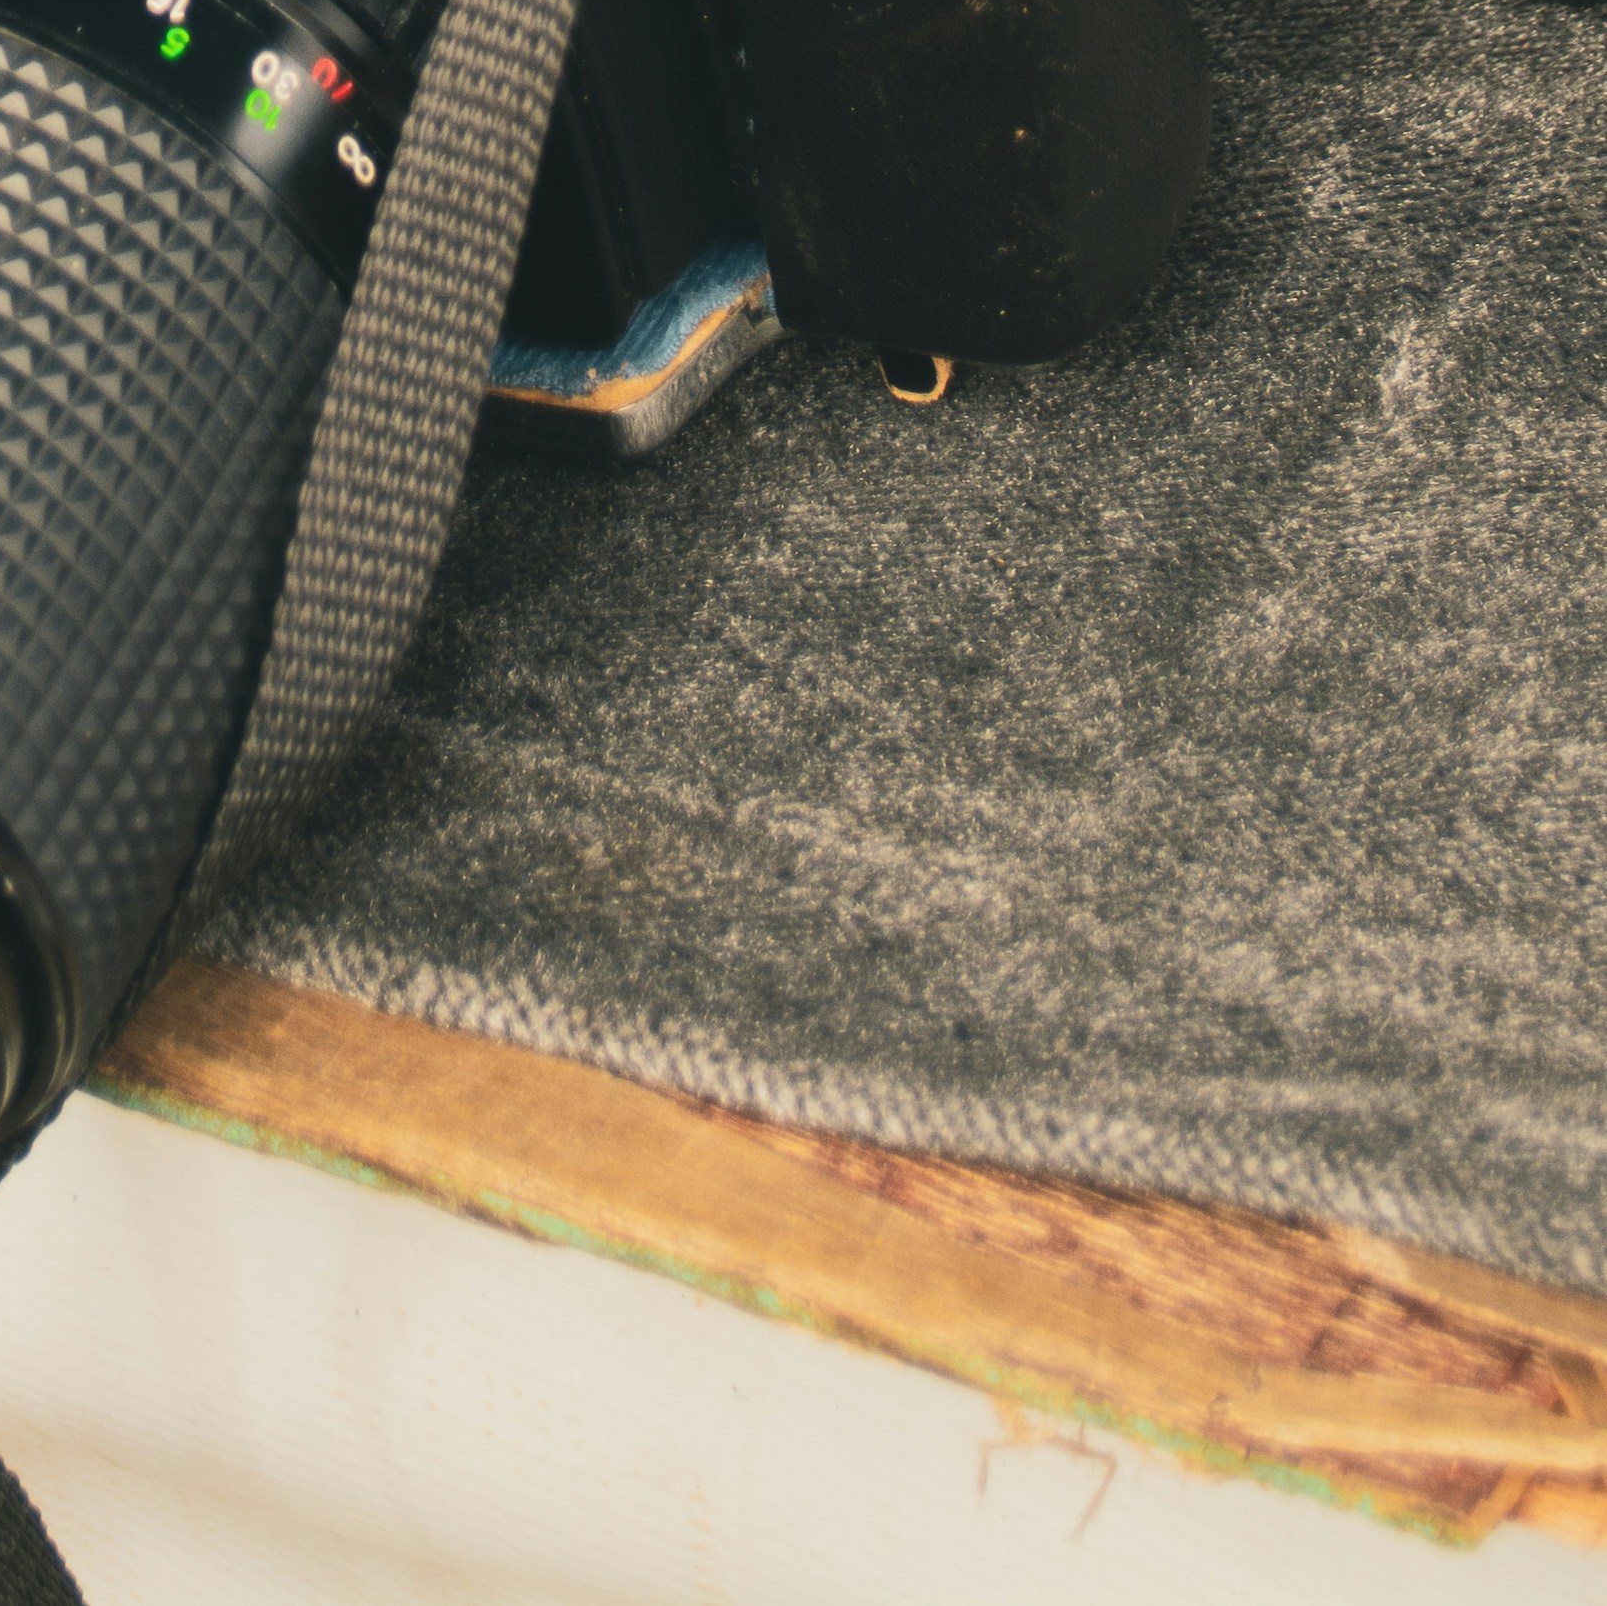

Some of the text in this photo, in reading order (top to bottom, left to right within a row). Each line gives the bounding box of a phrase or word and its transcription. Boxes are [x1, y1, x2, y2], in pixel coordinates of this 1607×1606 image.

[160, 27, 191, 62] 5
[250, 49, 300, 102] 30
[245, 87, 283, 133] 10
